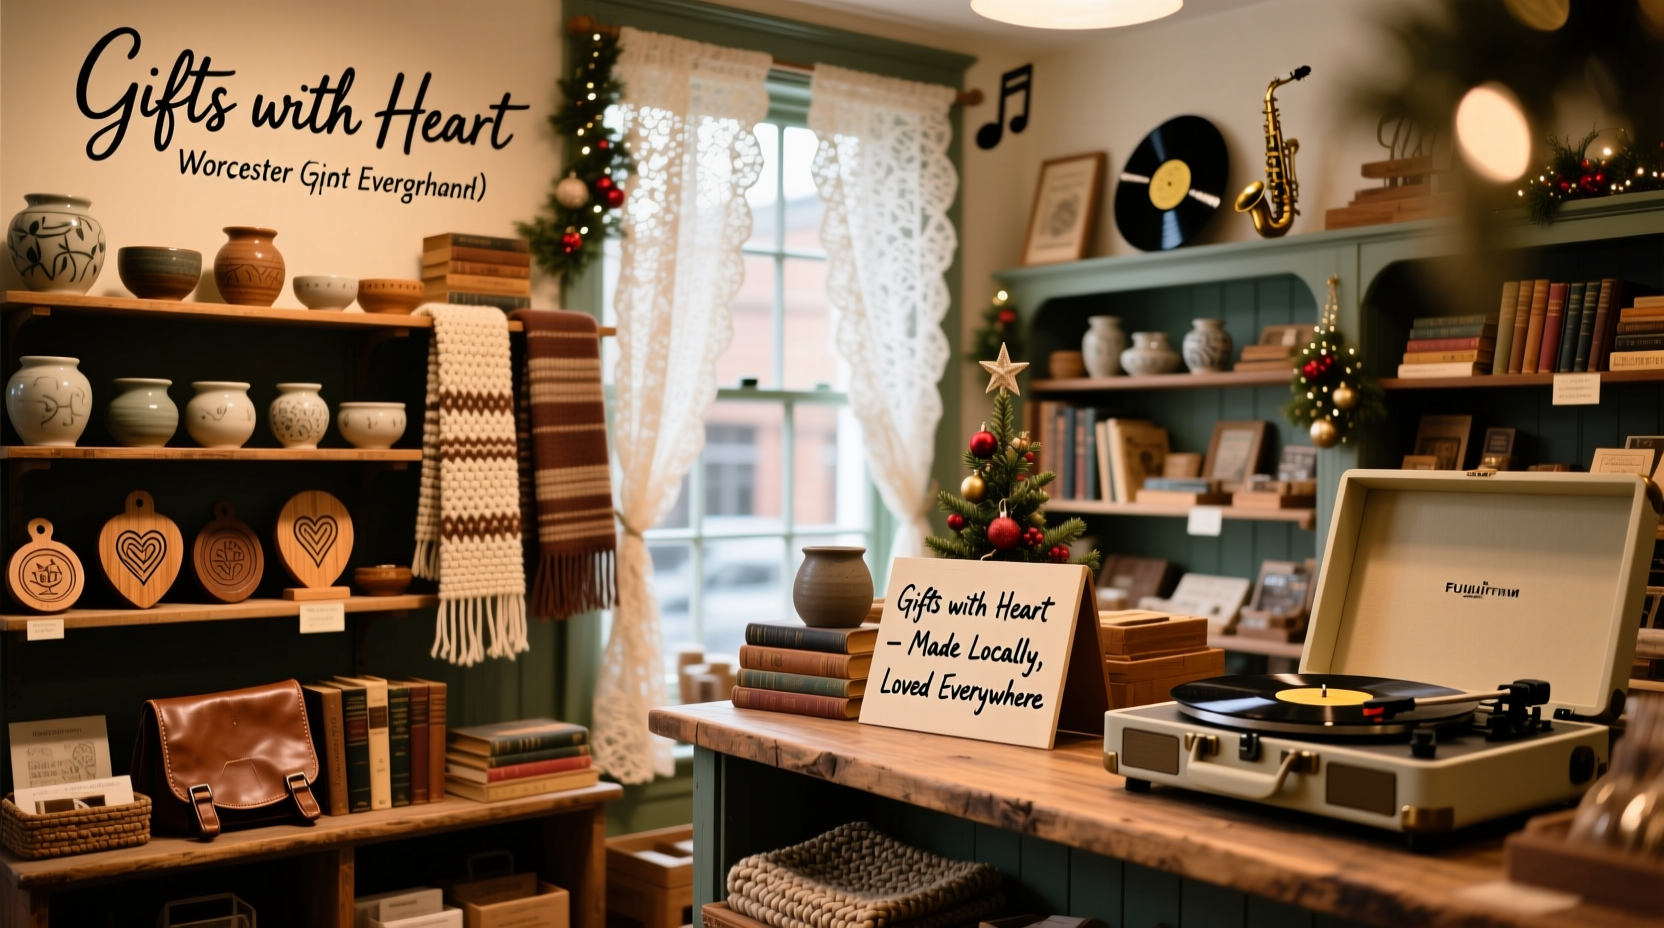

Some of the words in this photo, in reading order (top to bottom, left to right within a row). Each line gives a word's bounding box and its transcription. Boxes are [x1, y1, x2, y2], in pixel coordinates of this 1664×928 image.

[75, 26, 238, 162] Gifts
[251, 66, 363, 136] with
[374, 71, 531, 156] Heart
[179, 148, 294, 184] Worcester
[897, 583, 943, 624] Gifts
[948, 590, 987, 617] with
[995, 590, 1056, 623] Heart
[907, 629, 961, 659] Made
[967, 633, 1043, 678] Locally,
[880, 667, 935, 698] Loved
[938, 673, 1044, 716] Everywhere
